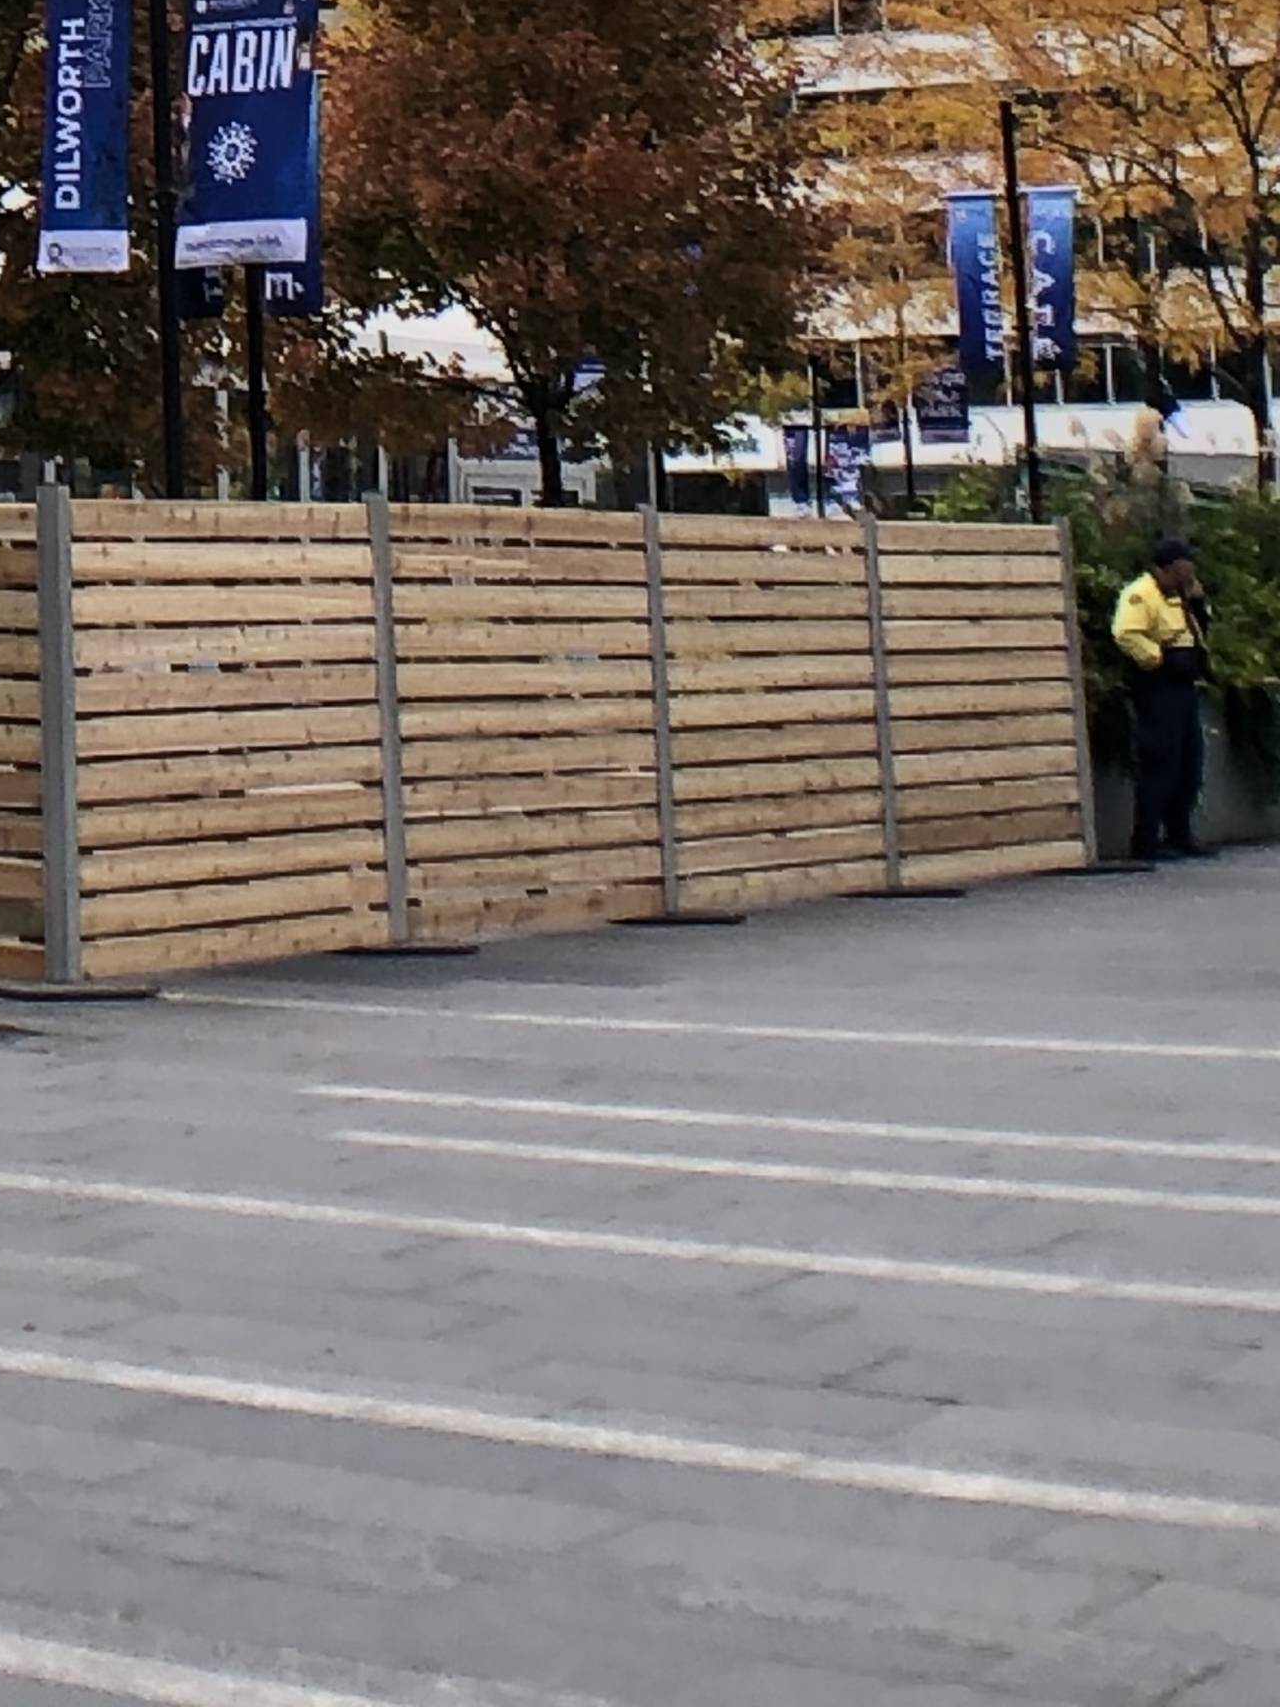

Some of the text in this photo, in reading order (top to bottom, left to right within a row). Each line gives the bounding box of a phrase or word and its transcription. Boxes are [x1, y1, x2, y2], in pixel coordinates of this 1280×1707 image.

[54, 17, 85, 211] DILWORTH
[188, 25, 297, 97] CABIN
[976, 232, 1004, 362] TERRACE
